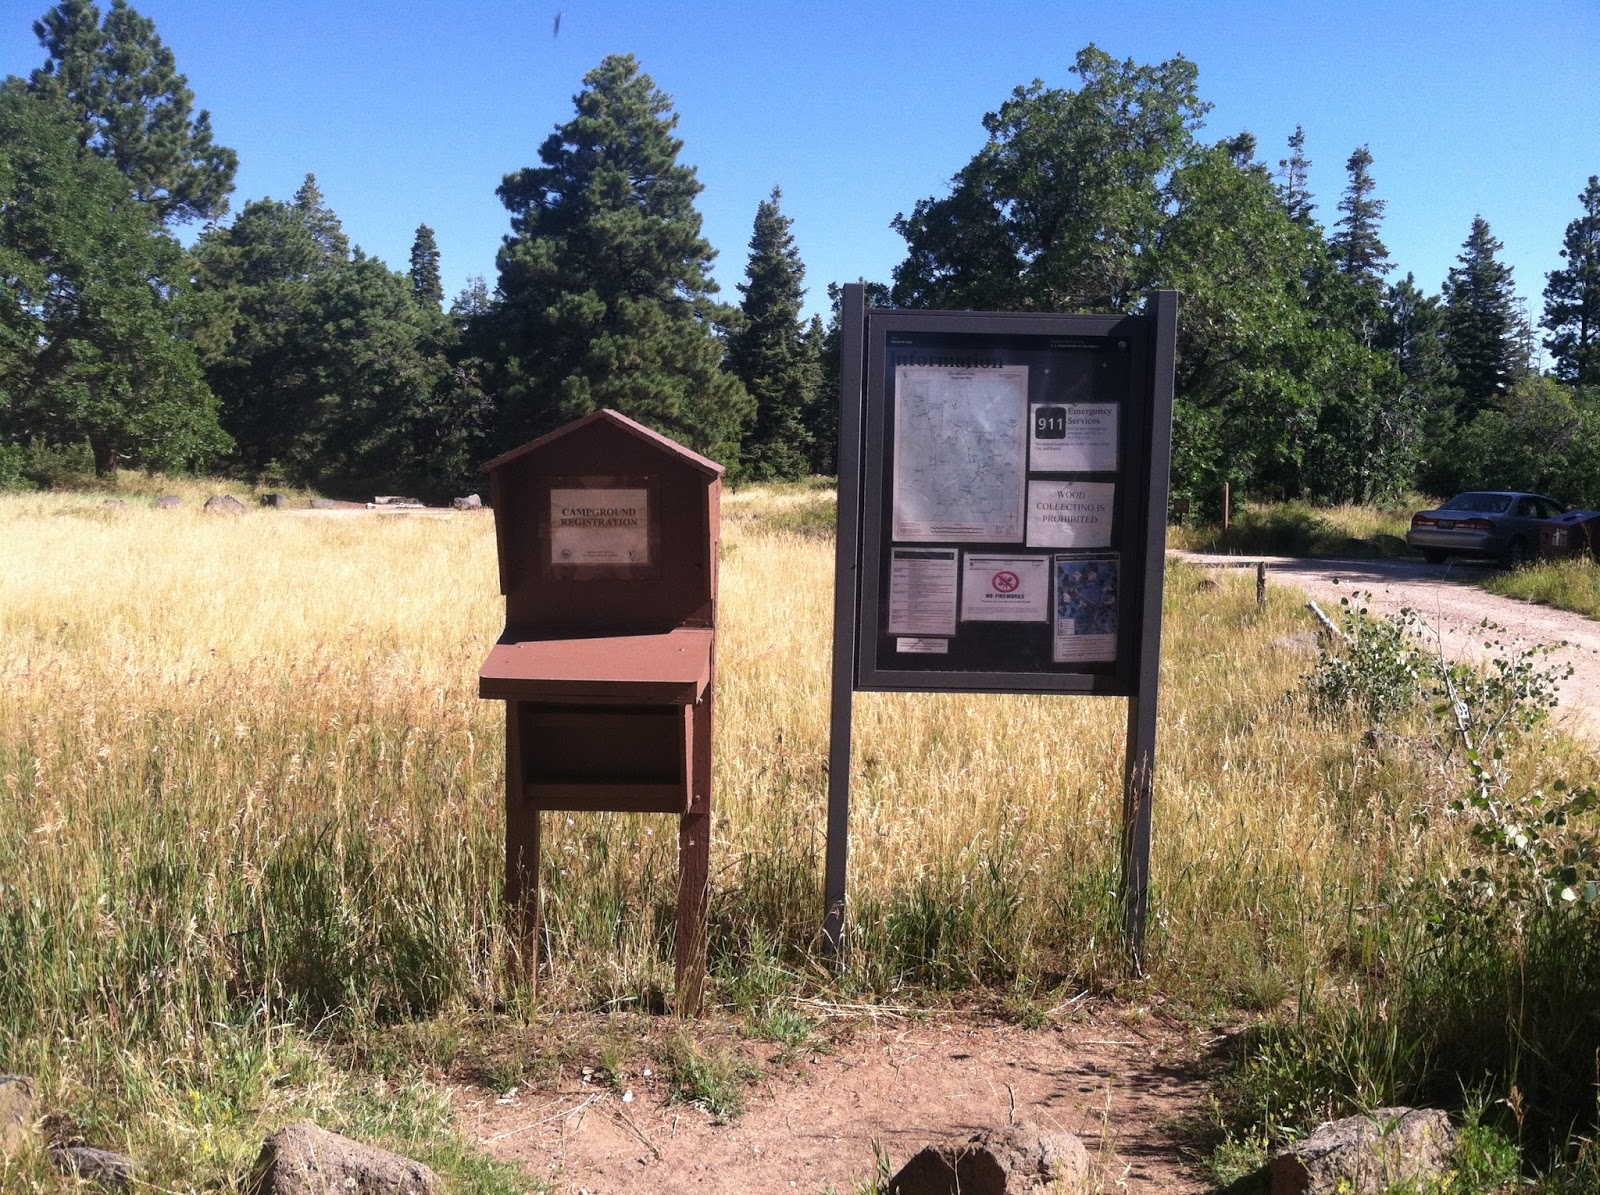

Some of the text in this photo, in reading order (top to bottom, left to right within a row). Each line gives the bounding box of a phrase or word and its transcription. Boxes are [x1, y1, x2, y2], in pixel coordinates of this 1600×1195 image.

[889, 351, 1004, 369] Information
[1067, 407, 1112, 416] Emergency
[1038, 418, 1063, 430] 911
[1057, 490, 1086, 499] WOOD
[1036, 502, 1105, 512] COLLECTING IS
[562, 508, 636, 517] CAMPGROUND
[560, 518, 638, 527] REGISTRATION
[1042, 514, 1098, 524] PROHIBITED
